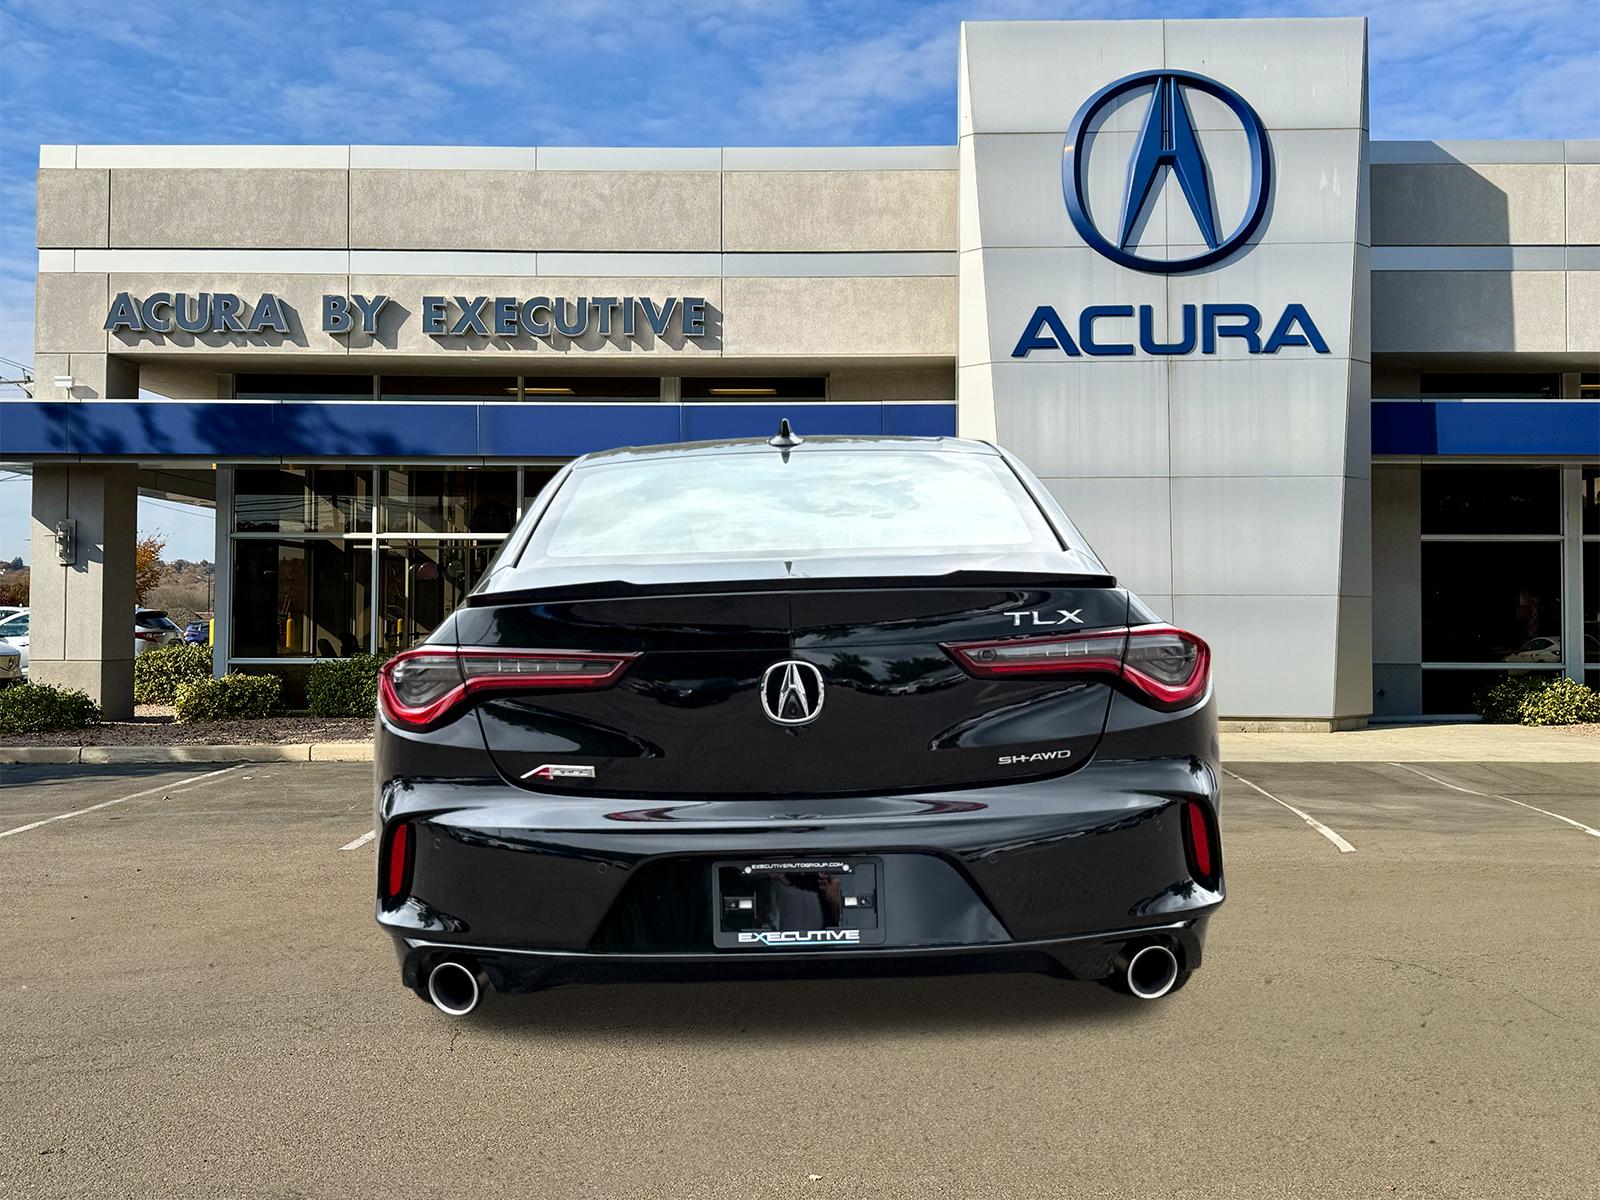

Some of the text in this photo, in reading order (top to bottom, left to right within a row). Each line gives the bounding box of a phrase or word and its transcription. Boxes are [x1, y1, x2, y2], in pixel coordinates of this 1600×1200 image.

[103, 291, 706, 337] ACURA BY EXECUTIVE
[1010, 303, 1332, 357] ACURA
[1003, 608, 1084, 626] TLX
[998, 749, 1072, 765] SH-AWD
[751, 862, 844, 870] EXECUTIVEAUTOGROUP.COM
[738, 930, 860, 945] EXECUTIVE
